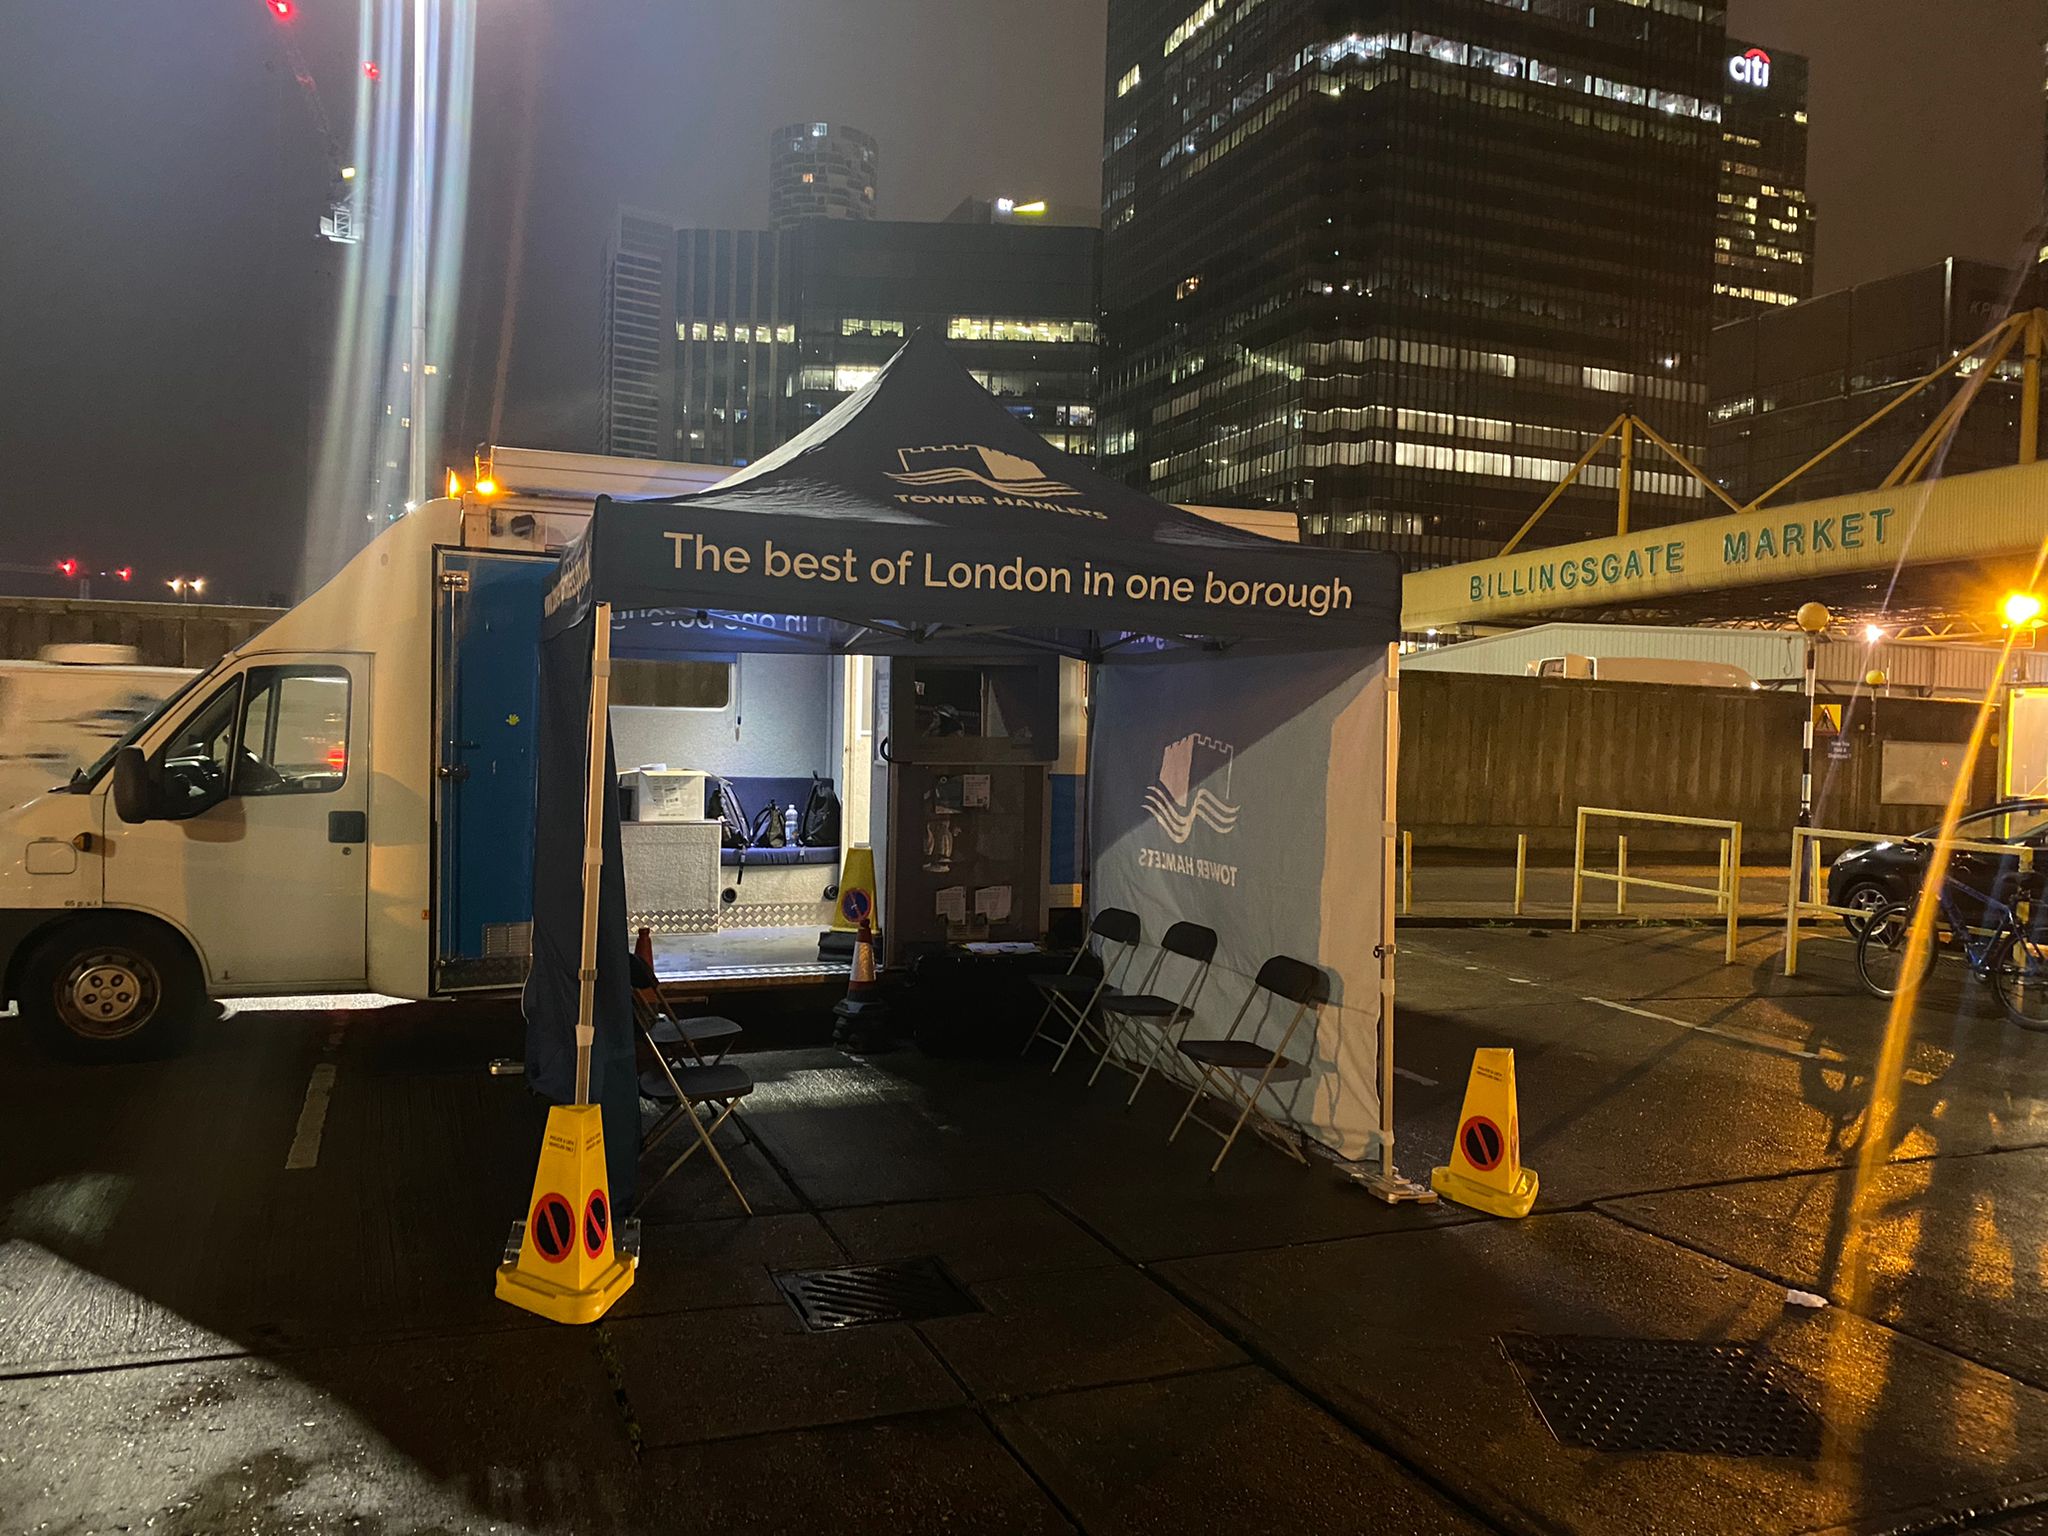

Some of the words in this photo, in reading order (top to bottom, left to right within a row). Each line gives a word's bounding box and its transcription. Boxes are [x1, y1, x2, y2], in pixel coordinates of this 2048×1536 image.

[1730, 51, 1770, 87] citi
[894, 494, 988, 505] TOWER
[993, 496, 1109, 520] HAMLETS
[663, 531, 751, 574] The
[765, 540, 858, 583] best
[870, 550, 914, 585] of
[924, 553, 1071, 594] London
[1083, 561, 1114, 597] in
[1126, 574, 1195, 602] one
[1204, 571, 1352, 617] borough
[1469, 541, 1685, 602] BILLINGSGATE
[1723, 508, 1893, 564] MARKET
